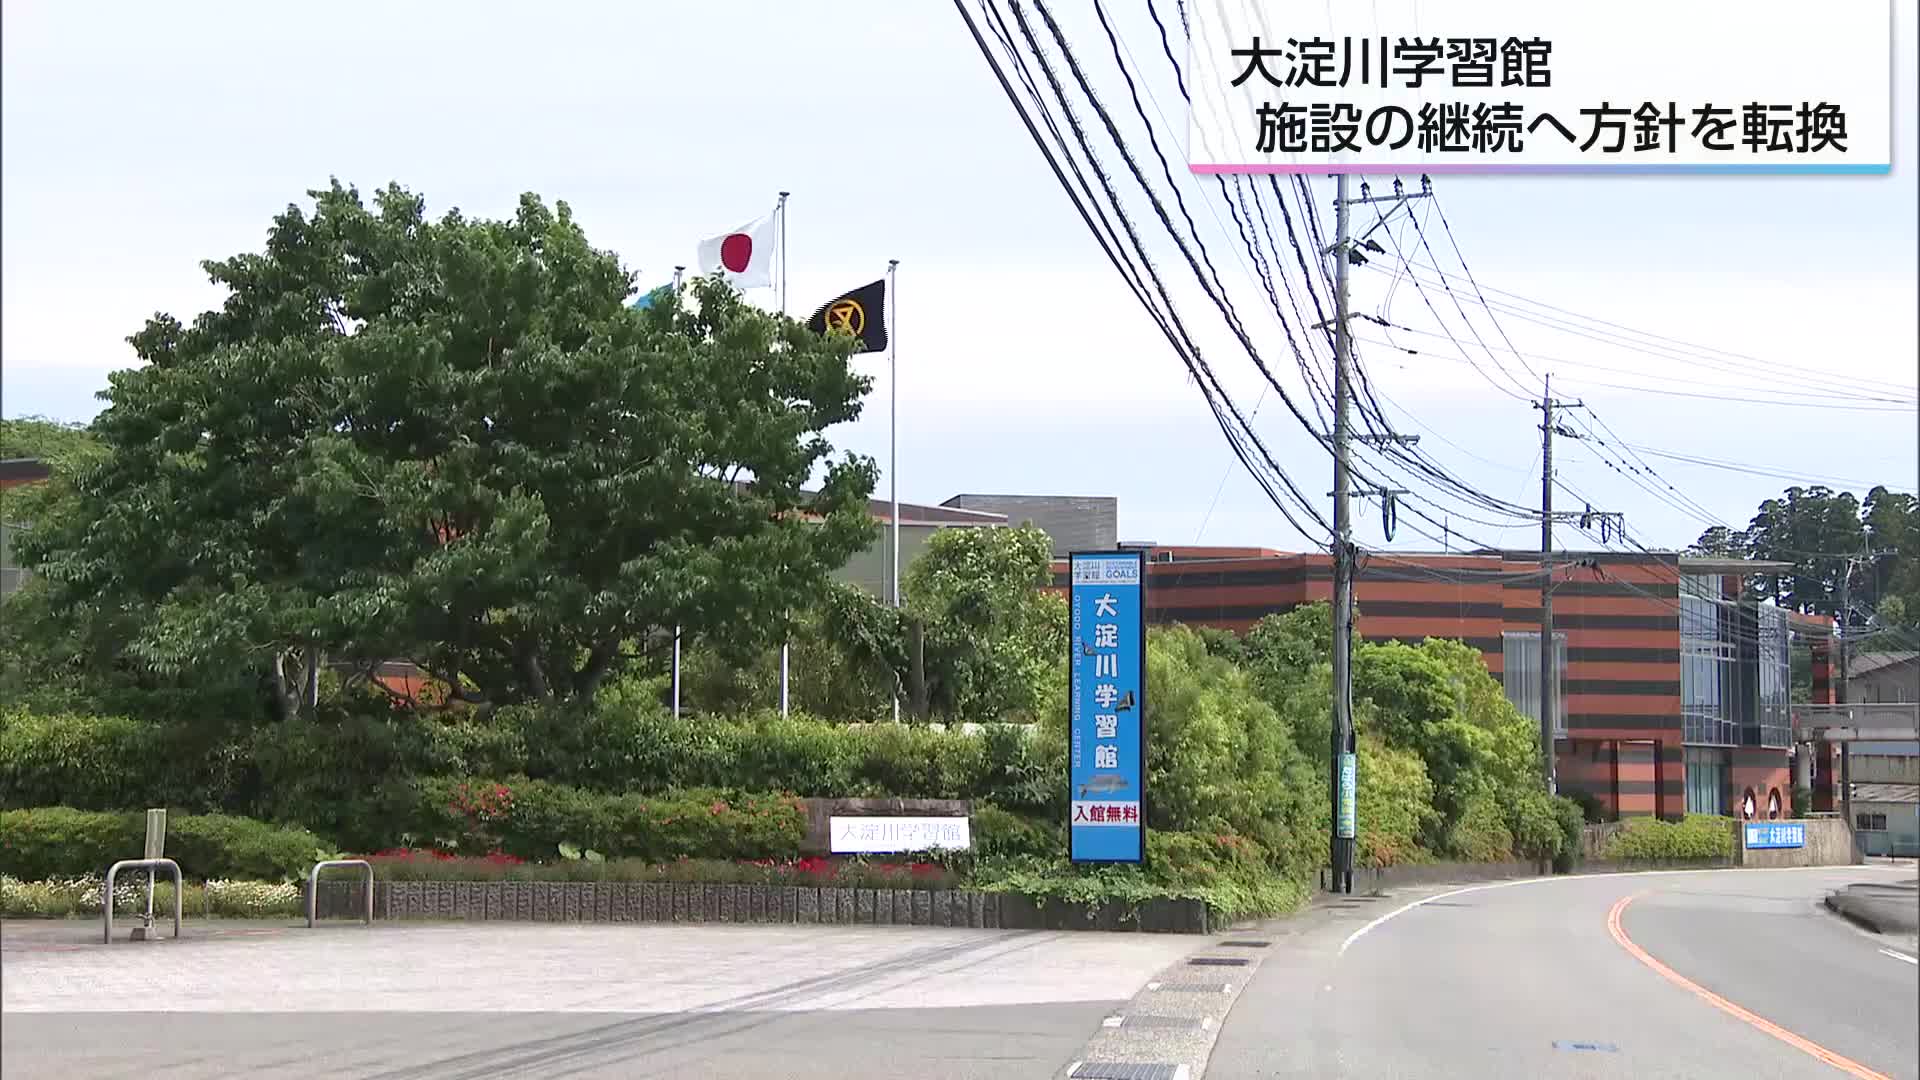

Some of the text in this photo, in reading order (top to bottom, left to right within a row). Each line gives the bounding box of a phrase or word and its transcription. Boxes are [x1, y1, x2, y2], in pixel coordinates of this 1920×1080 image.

[1105, 569, 1138, 578] GOALS
[1094, 592, 1118, 768] 大淀川学習館
[1074, 804, 1138, 823] 入館無料
